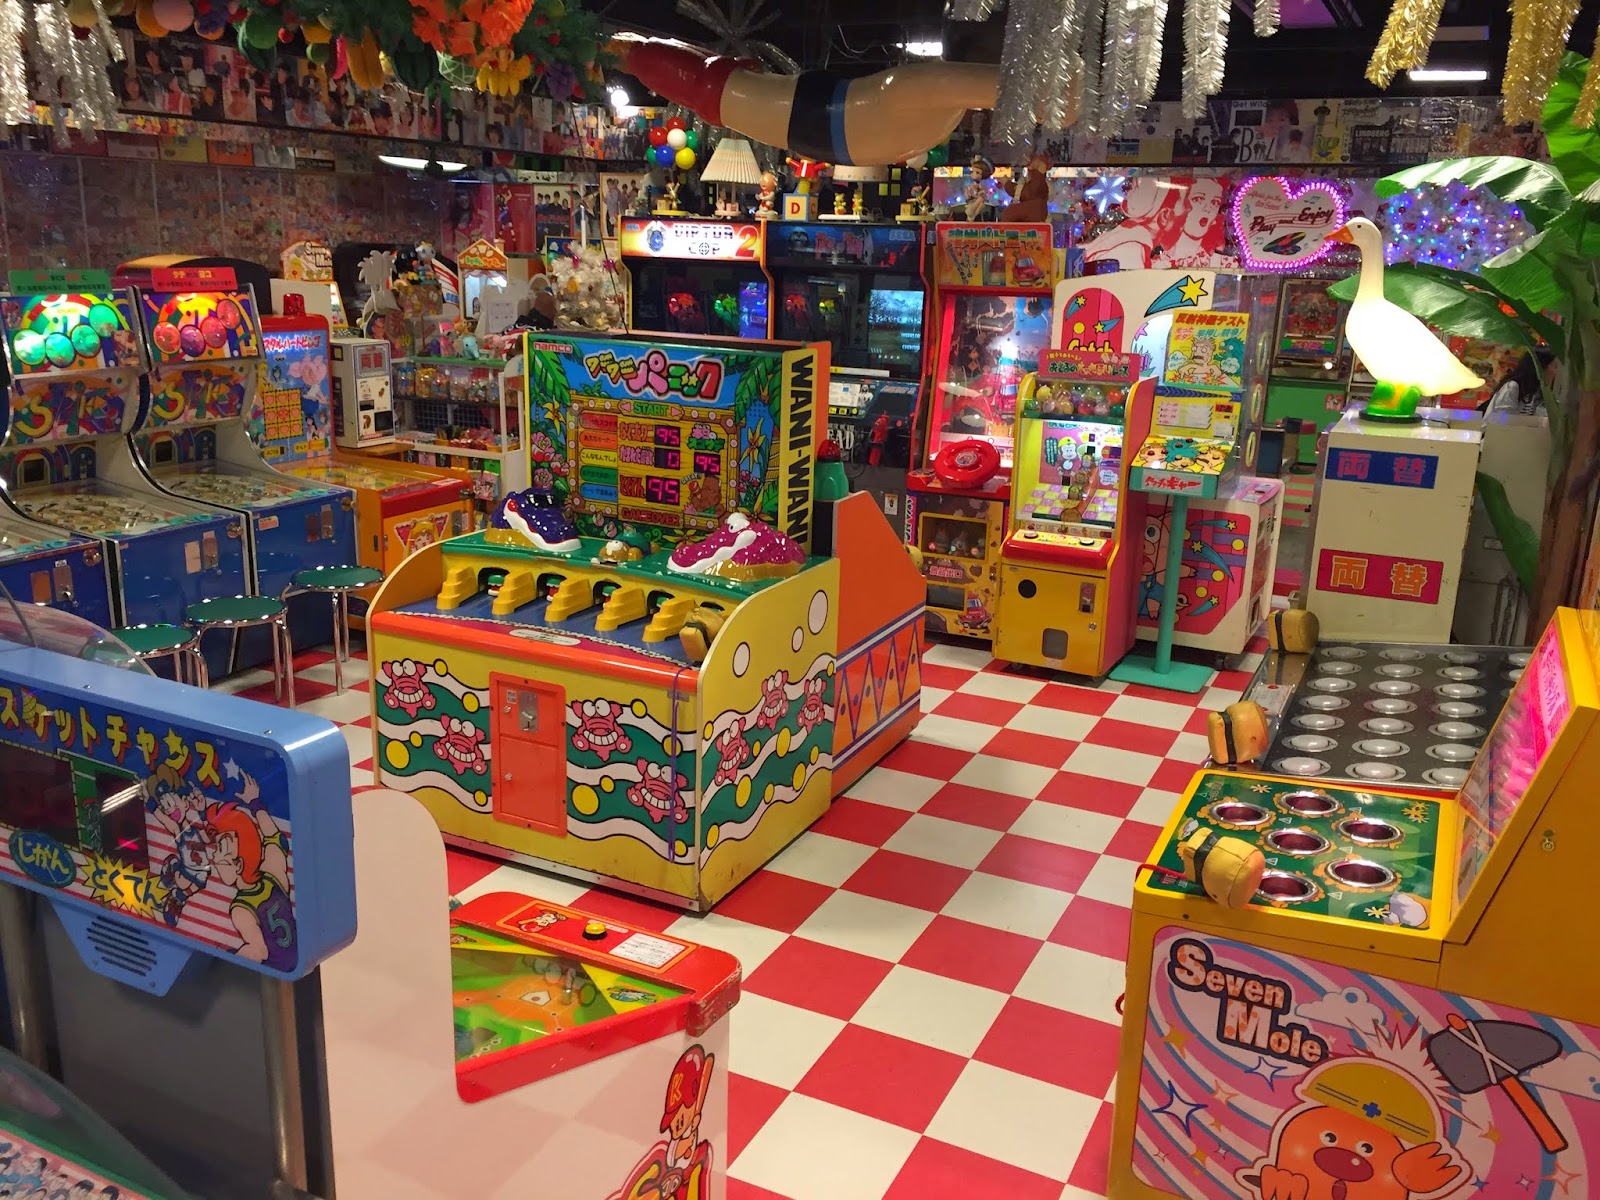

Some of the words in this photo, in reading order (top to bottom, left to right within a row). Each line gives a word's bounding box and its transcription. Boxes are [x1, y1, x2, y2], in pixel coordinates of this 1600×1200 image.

[1355, 129, 1390, 138] LINDBERG
[791, 202, 801, 214] D
[1249, 215, 1277, 235] Play
[735, 225, 759, 258] 2
[534, 341, 572, 353] namco
[585, 349, 722, 399] ワニワニパニック
[633, 402, 669, 417] START
[656, 428, 680, 446] 95
[695, 455, 720, 473] 95
[1337, 451, 1426, 485] 両替
[647, 477, 679, 503] 95
[1329, 554, 1428, 597] 両替
[17, 835, 70, 875] じかん
[94, 867, 164, 910] とくてん
[268, 903, 292, 948] 5
[1173, 941, 1288, 1010] Seven
[1222, 997, 1324, 1065] Mole
[669, 1073, 684, 1105] K
